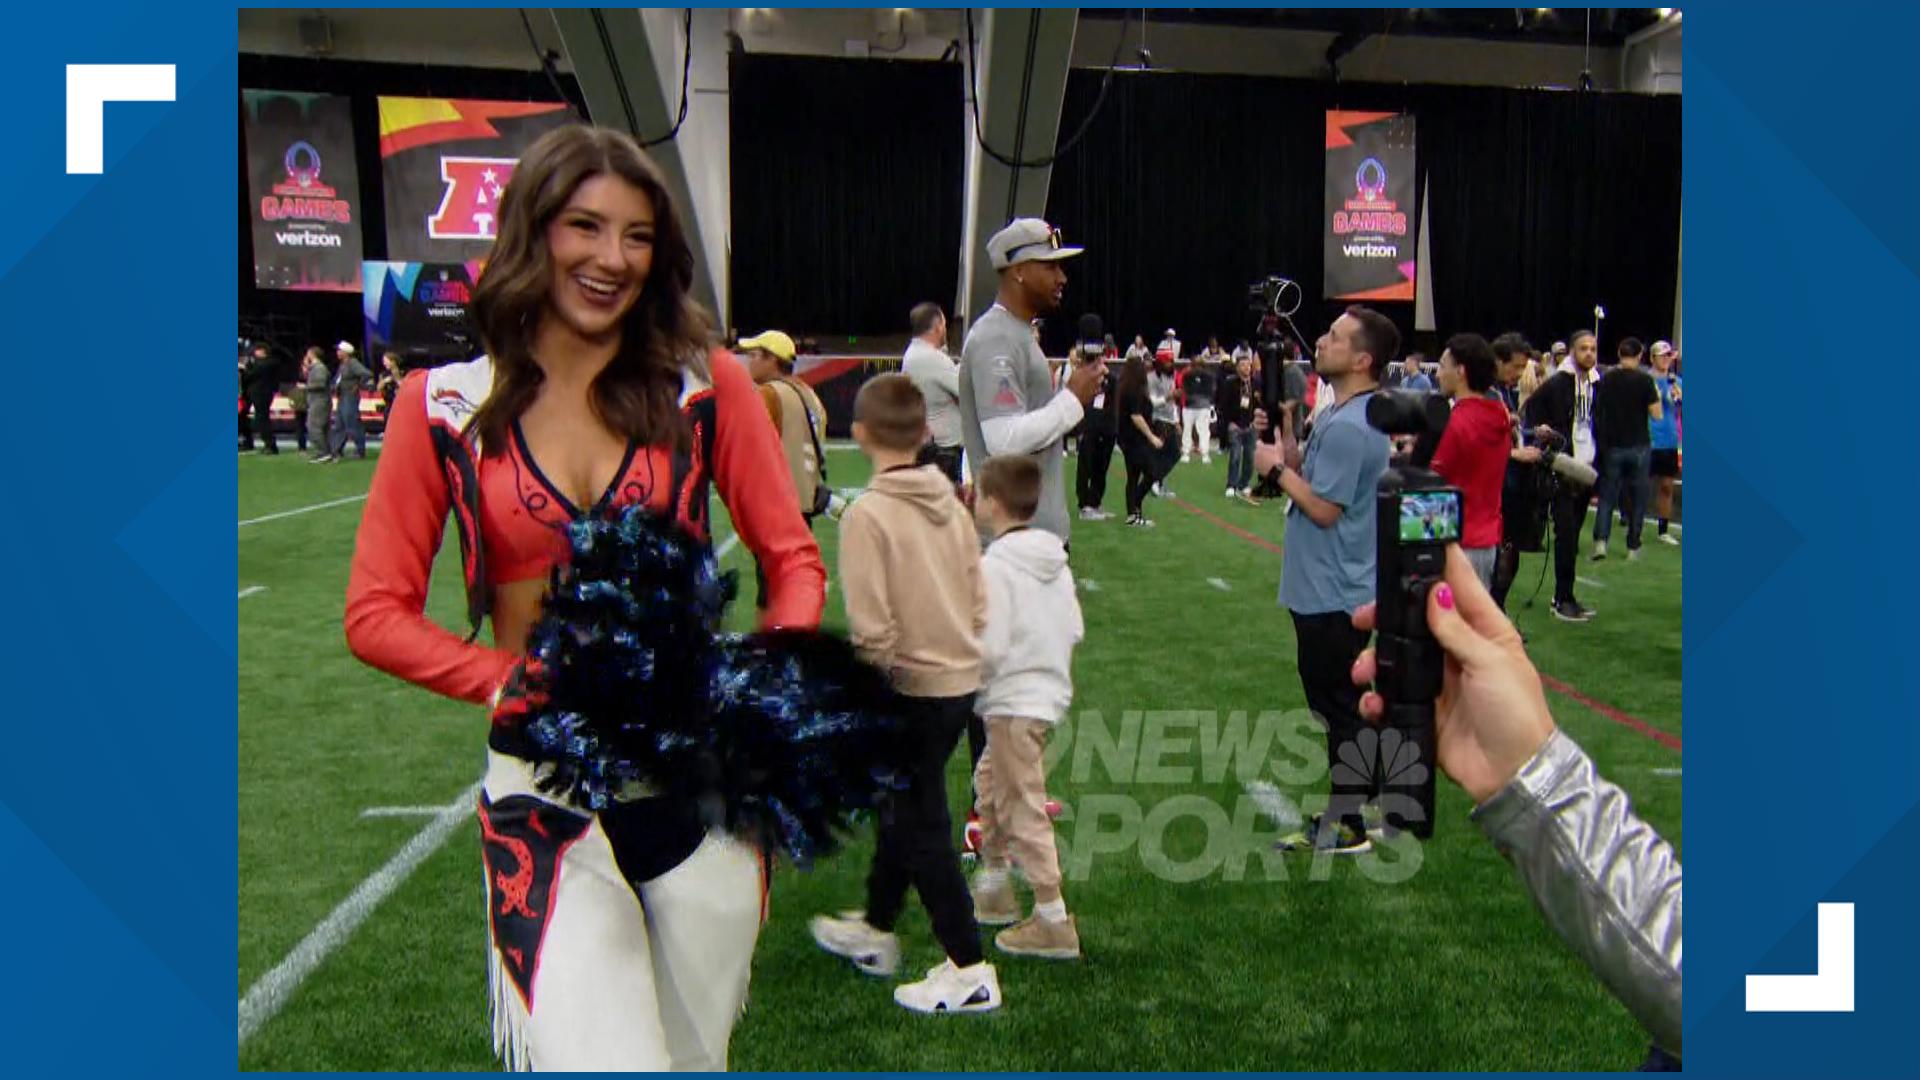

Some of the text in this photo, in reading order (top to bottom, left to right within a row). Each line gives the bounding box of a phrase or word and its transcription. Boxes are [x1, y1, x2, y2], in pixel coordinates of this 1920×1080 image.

[428, 156, 521, 239] A
[261, 196, 351, 223] GAMES
[1333, 210, 1406, 235] GAMES
[275, 230, 342, 247] verizon
[1342, 243, 1397, 257] verizon
[428, 306, 465, 317] verizon
